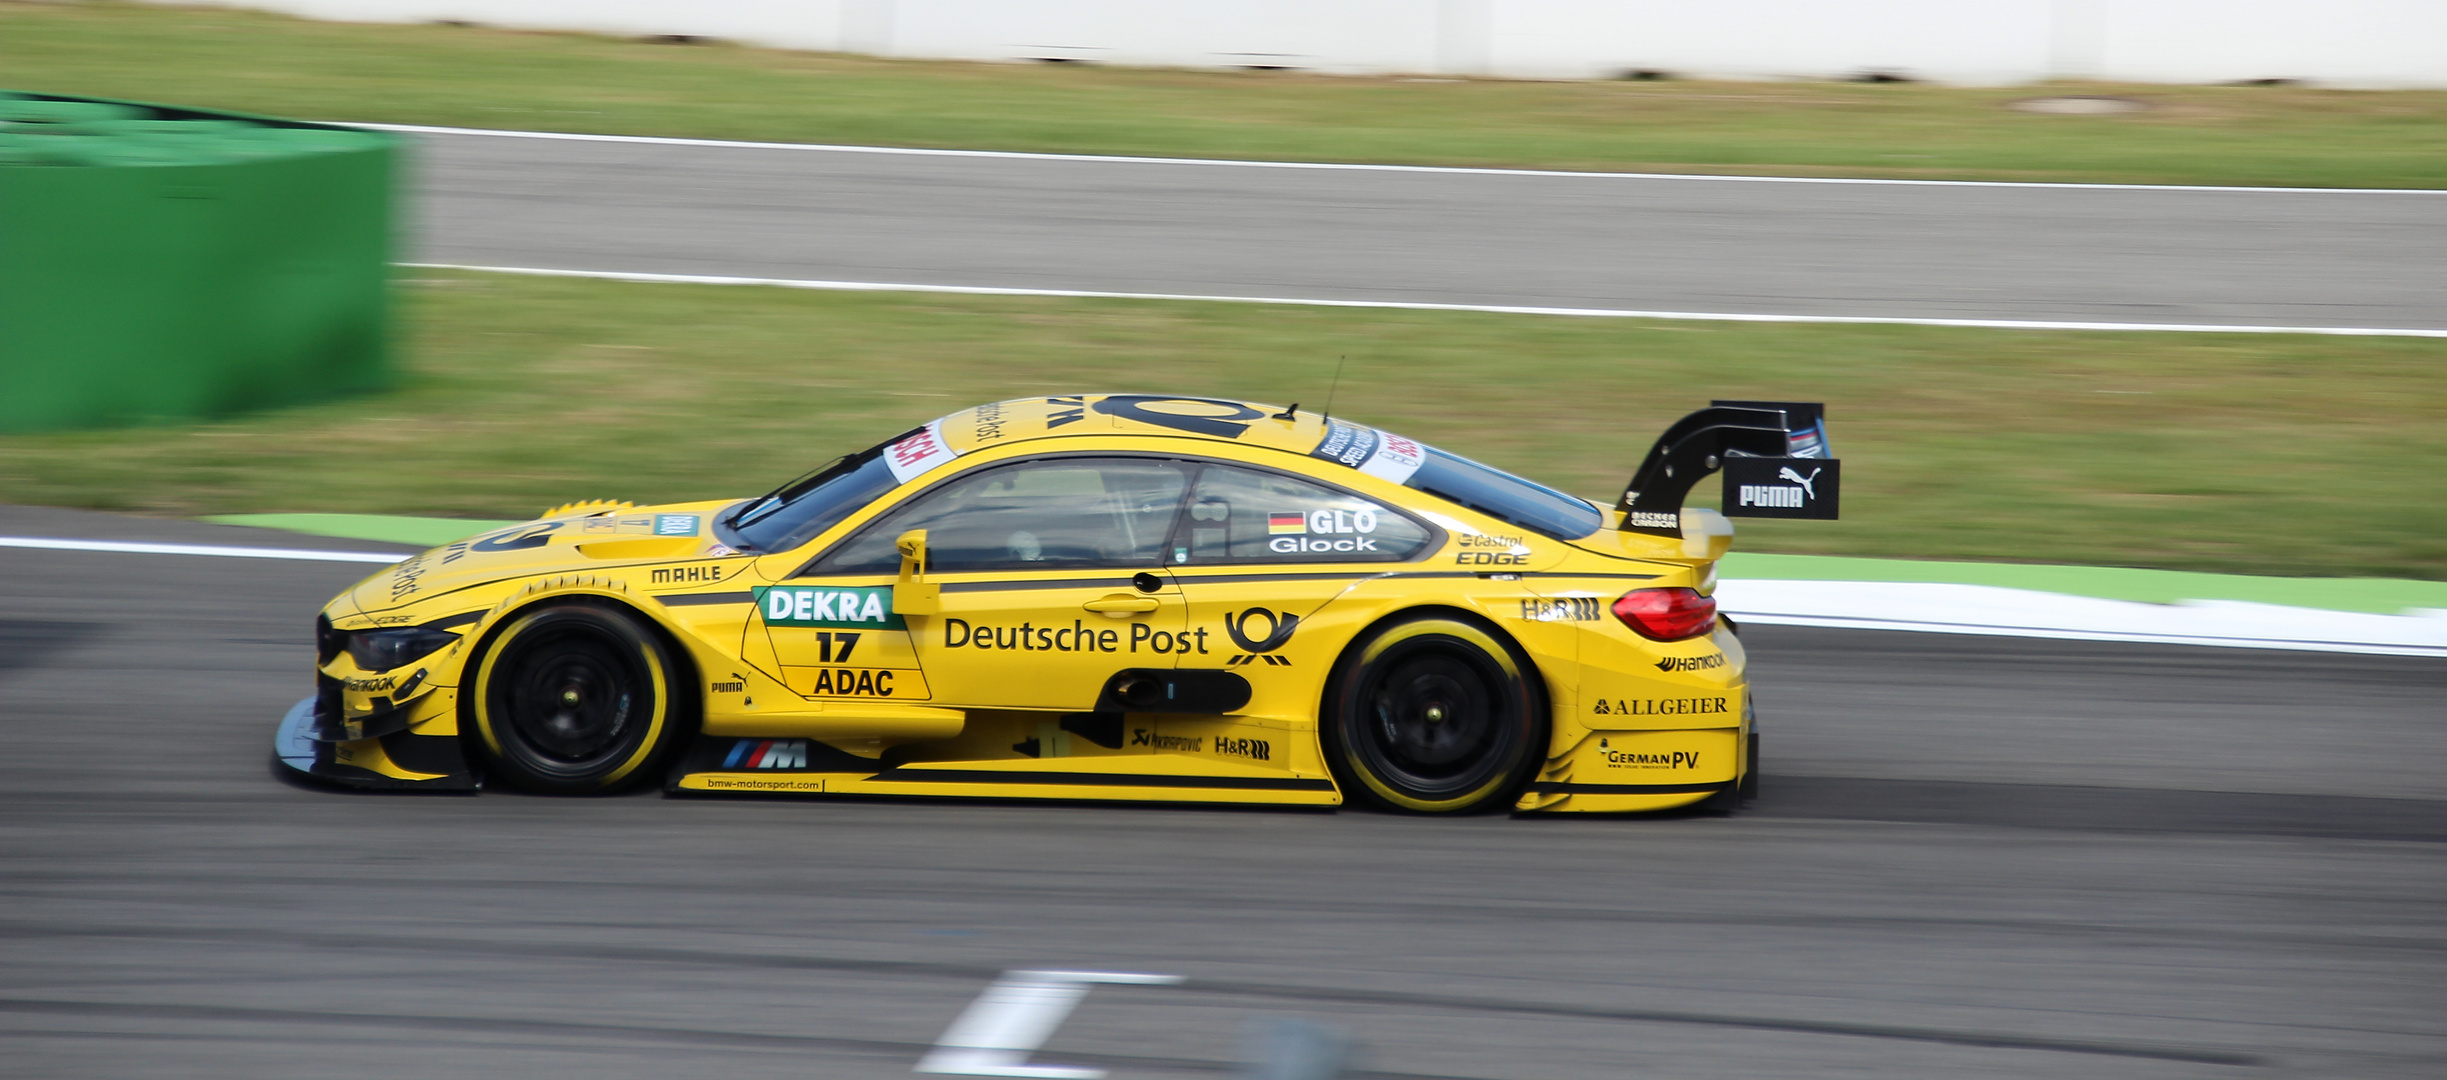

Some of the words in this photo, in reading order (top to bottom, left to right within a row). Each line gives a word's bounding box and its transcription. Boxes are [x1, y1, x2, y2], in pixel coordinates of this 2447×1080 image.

[893, 424, 940, 468] SCH
[1339, 446, 1368, 467] SPEED
[1739, 485, 1803, 508] PUMA
[1309, 509, 1378, 534] GLO
[1631, 511, 1677, 521] BECKER
[1631, 519, 1678, 529] CARBON
[1268, 536, 1378, 553] Glock
[1473, 534, 1523, 548] Castrol
[1455, 551, 1532, 566] EDGE
[651, 565, 721, 583] MAHLE
[768, 590, 886, 622] DEKRA
[944, 618, 1119, 652] Deutsche
[1129, 622, 1209, 655] Post
[815, 631, 862, 663] 17
[711, 682, 743, 693] PUMA
[813, 668, 894, 697] ADAC
[1613, 697, 1728, 715] ALLGEIER
[1215, 736, 1249, 756] H&R
[707, 779, 819, 790] bmw-motorsport.com
